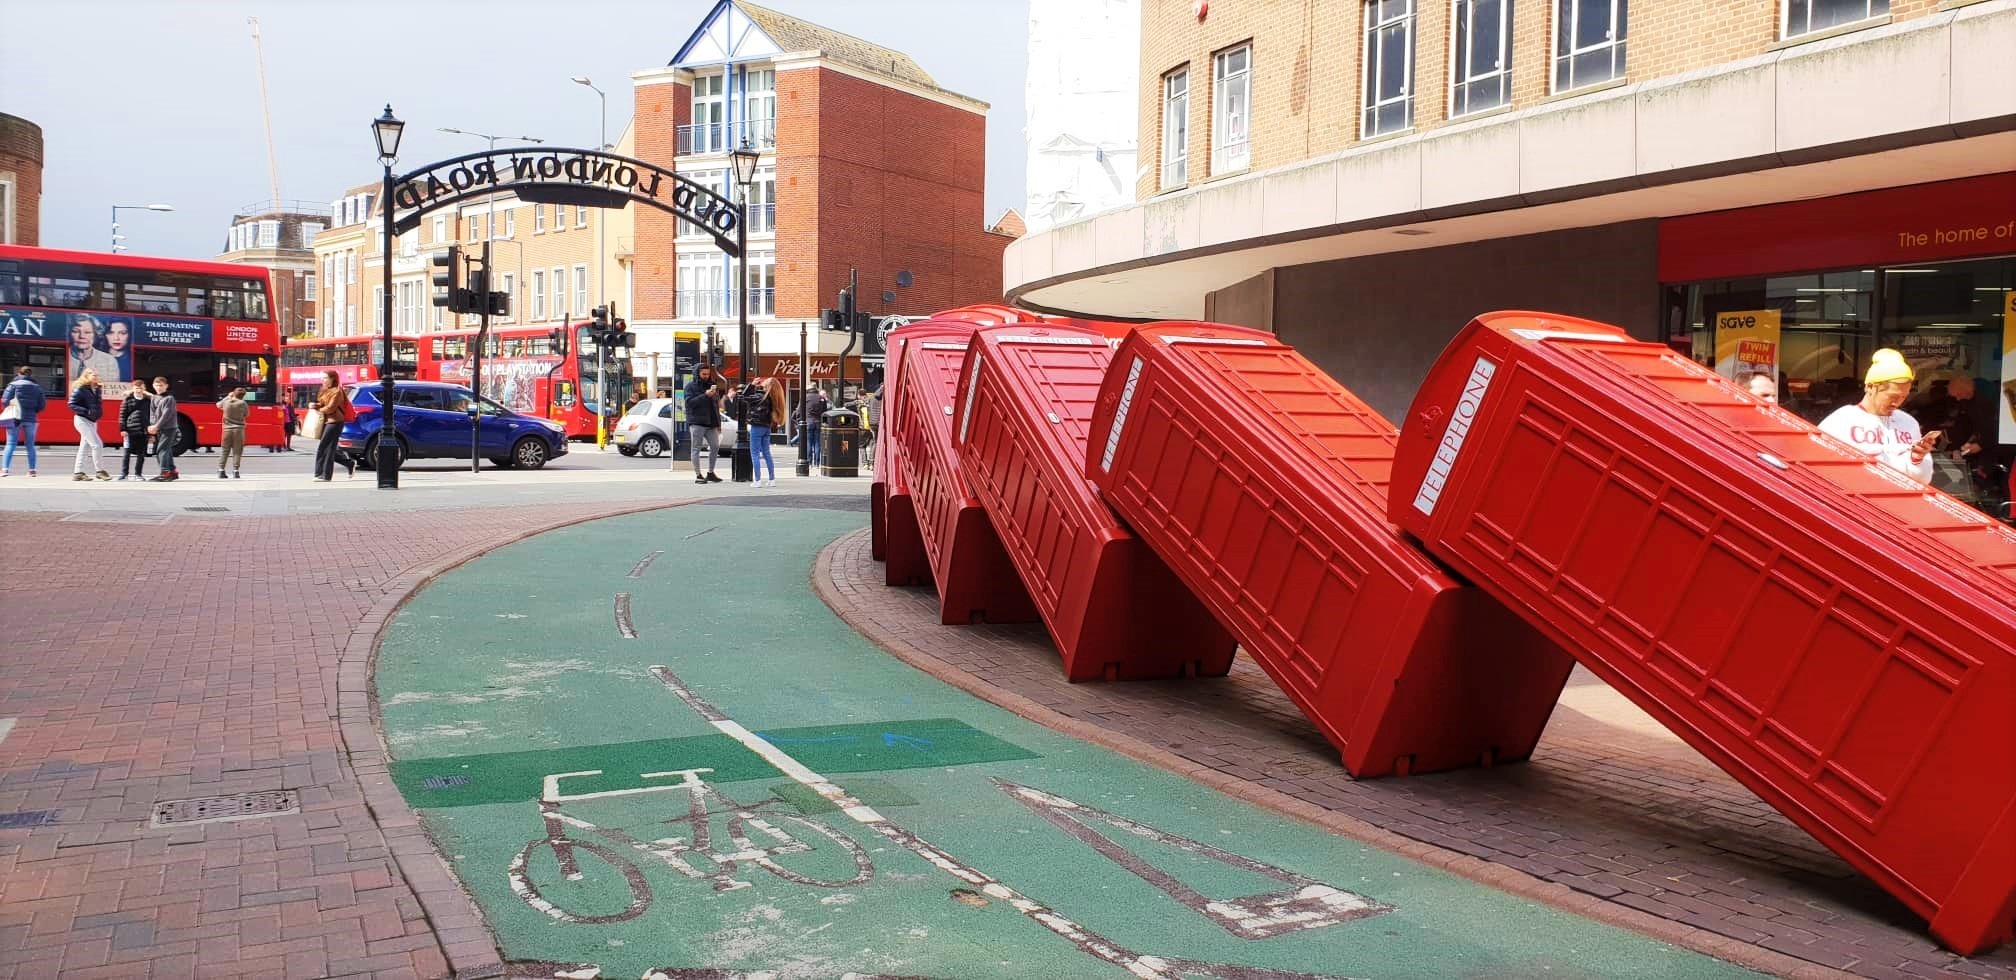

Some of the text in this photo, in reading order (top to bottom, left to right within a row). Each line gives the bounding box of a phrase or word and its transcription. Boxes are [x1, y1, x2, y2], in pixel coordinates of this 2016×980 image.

[1898, 221, 2014, 248] The home of
[0, 317, 46, 336] AN
[1720, 315, 1756, 329] save
[1745, 342, 1770, 352] TWIN
[1739, 352, 1772, 363] REFILL
[808, 359, 839, 375] Hut
[1103, 360, 1142, 467] TELEPHONE
[1418, 364, 1492, 505] TELEPHONE
